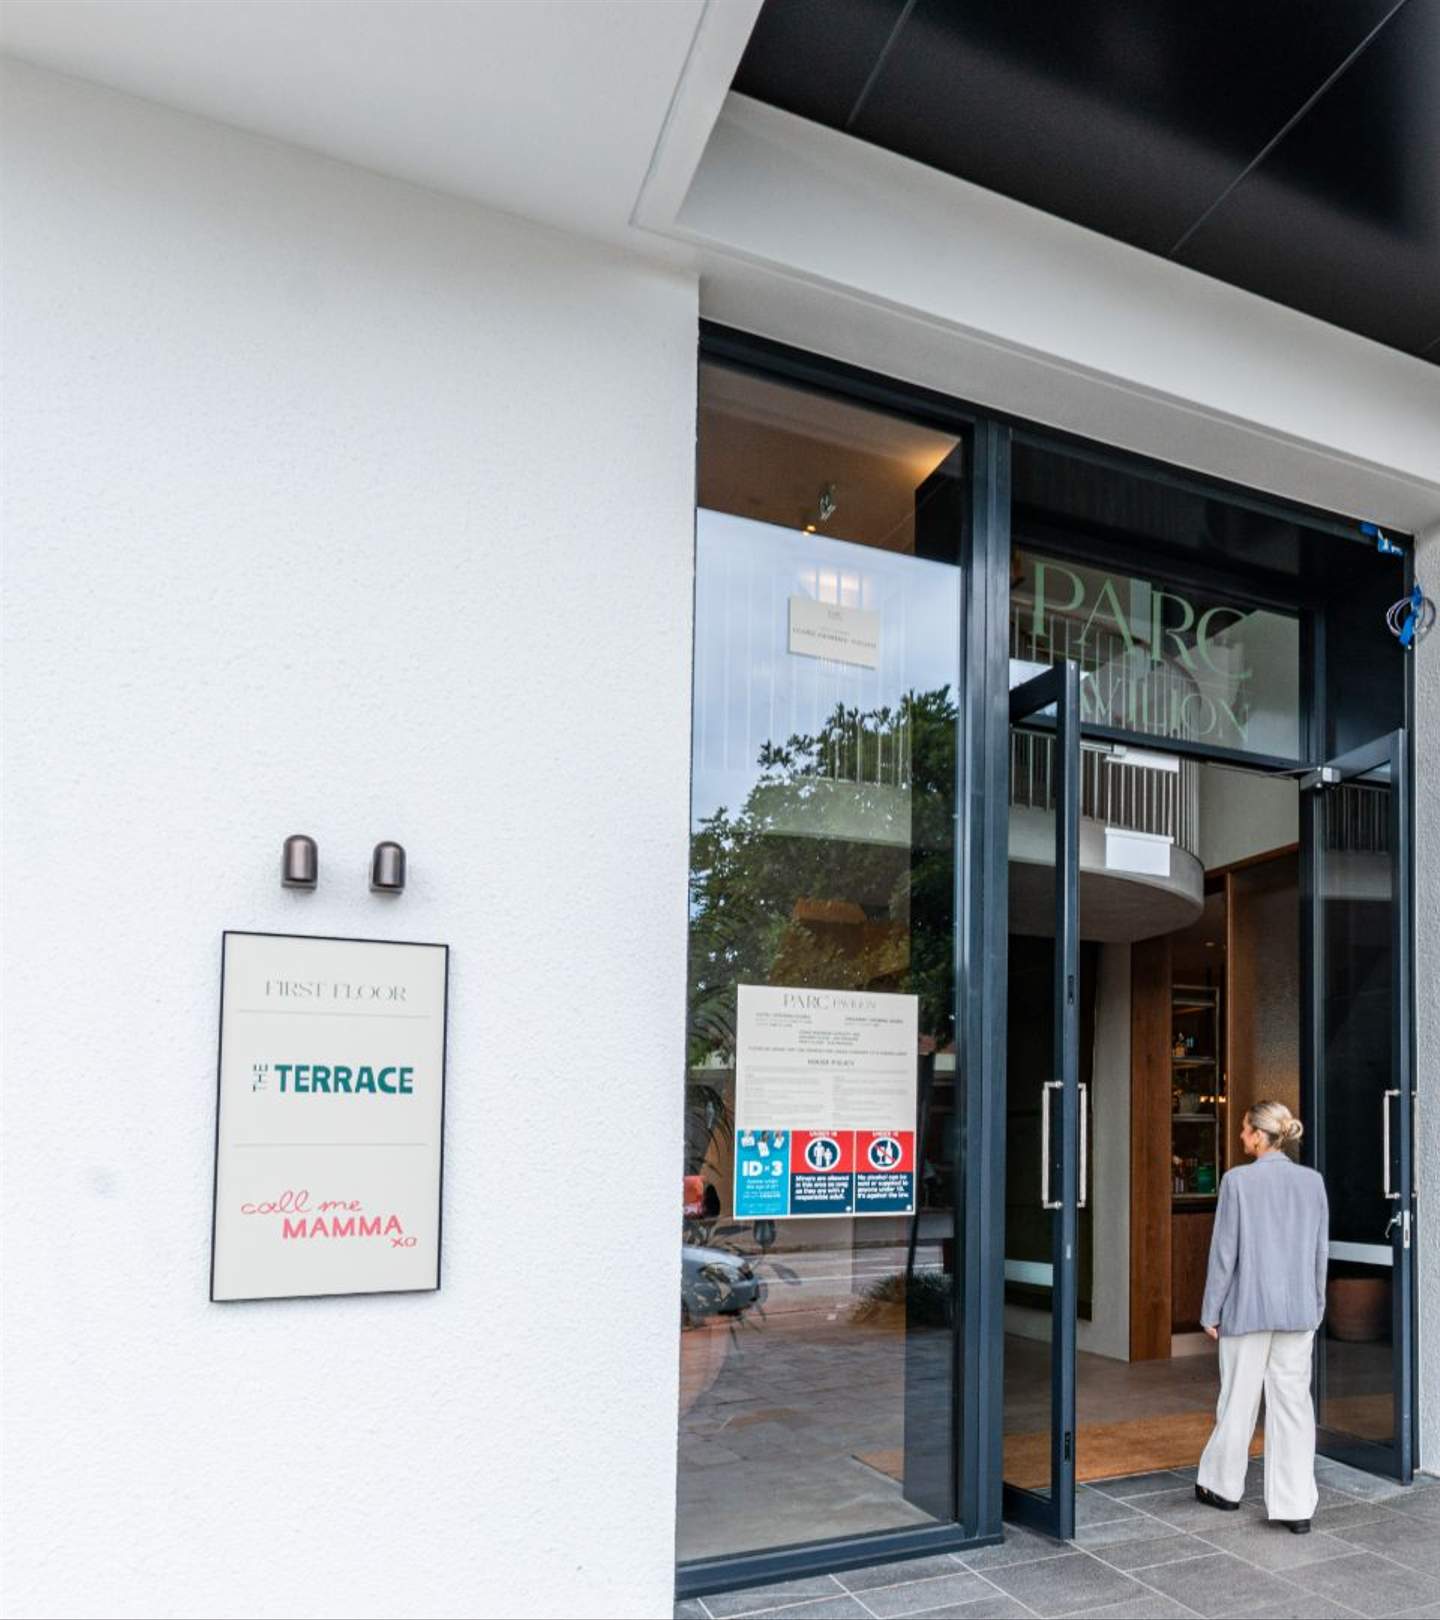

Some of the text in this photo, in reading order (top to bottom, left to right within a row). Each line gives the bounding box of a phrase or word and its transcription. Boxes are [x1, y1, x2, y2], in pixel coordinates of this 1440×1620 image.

[1030, 561, 1254, 680] PARC
[266, 980, 407, 1001] FIRST FLOOR
[783, 993, 828, 1009] PARC
[274, 1064, 414, 1094] TERRACE
[742, 1161, 783, 1177] ID 3
[241, 1190, 362, 1214] call me
[282, 1215, 403, 1239] MAMMA
